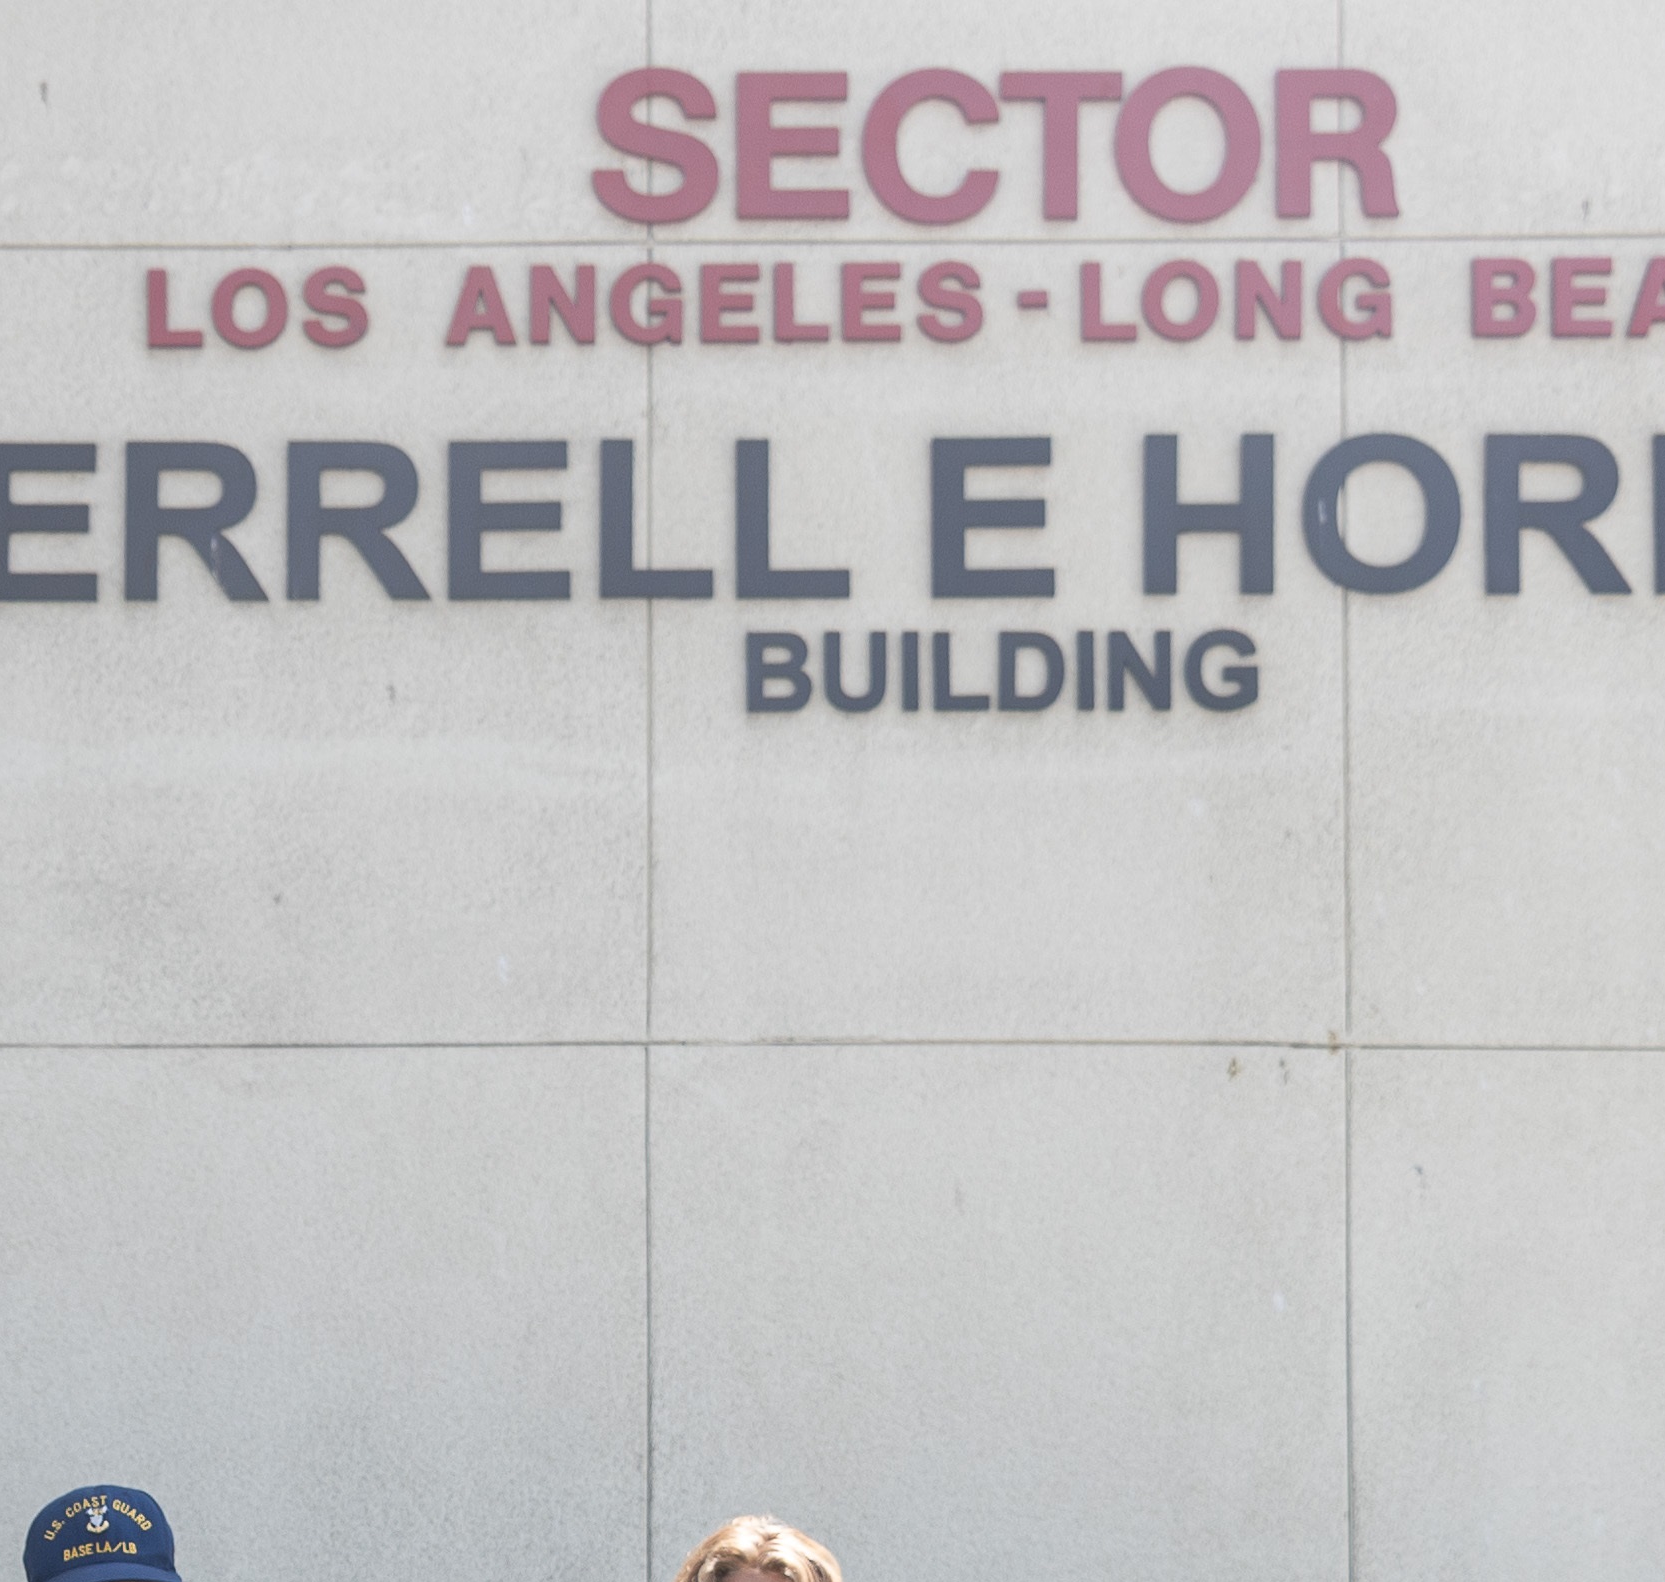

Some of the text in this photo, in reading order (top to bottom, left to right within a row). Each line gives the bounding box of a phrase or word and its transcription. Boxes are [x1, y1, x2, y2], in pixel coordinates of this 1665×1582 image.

[593, 68, 1398, 224] SECTOR
[147, 267, 369, 350] LOS
[930, 436, 1057, 600] E
[745, 630, 1261, 716] BUILDING
[44, 1495, 153, 1541] U.S. COAST GUARD
[63, 1540, 138, 1562] BASE LA/LB
